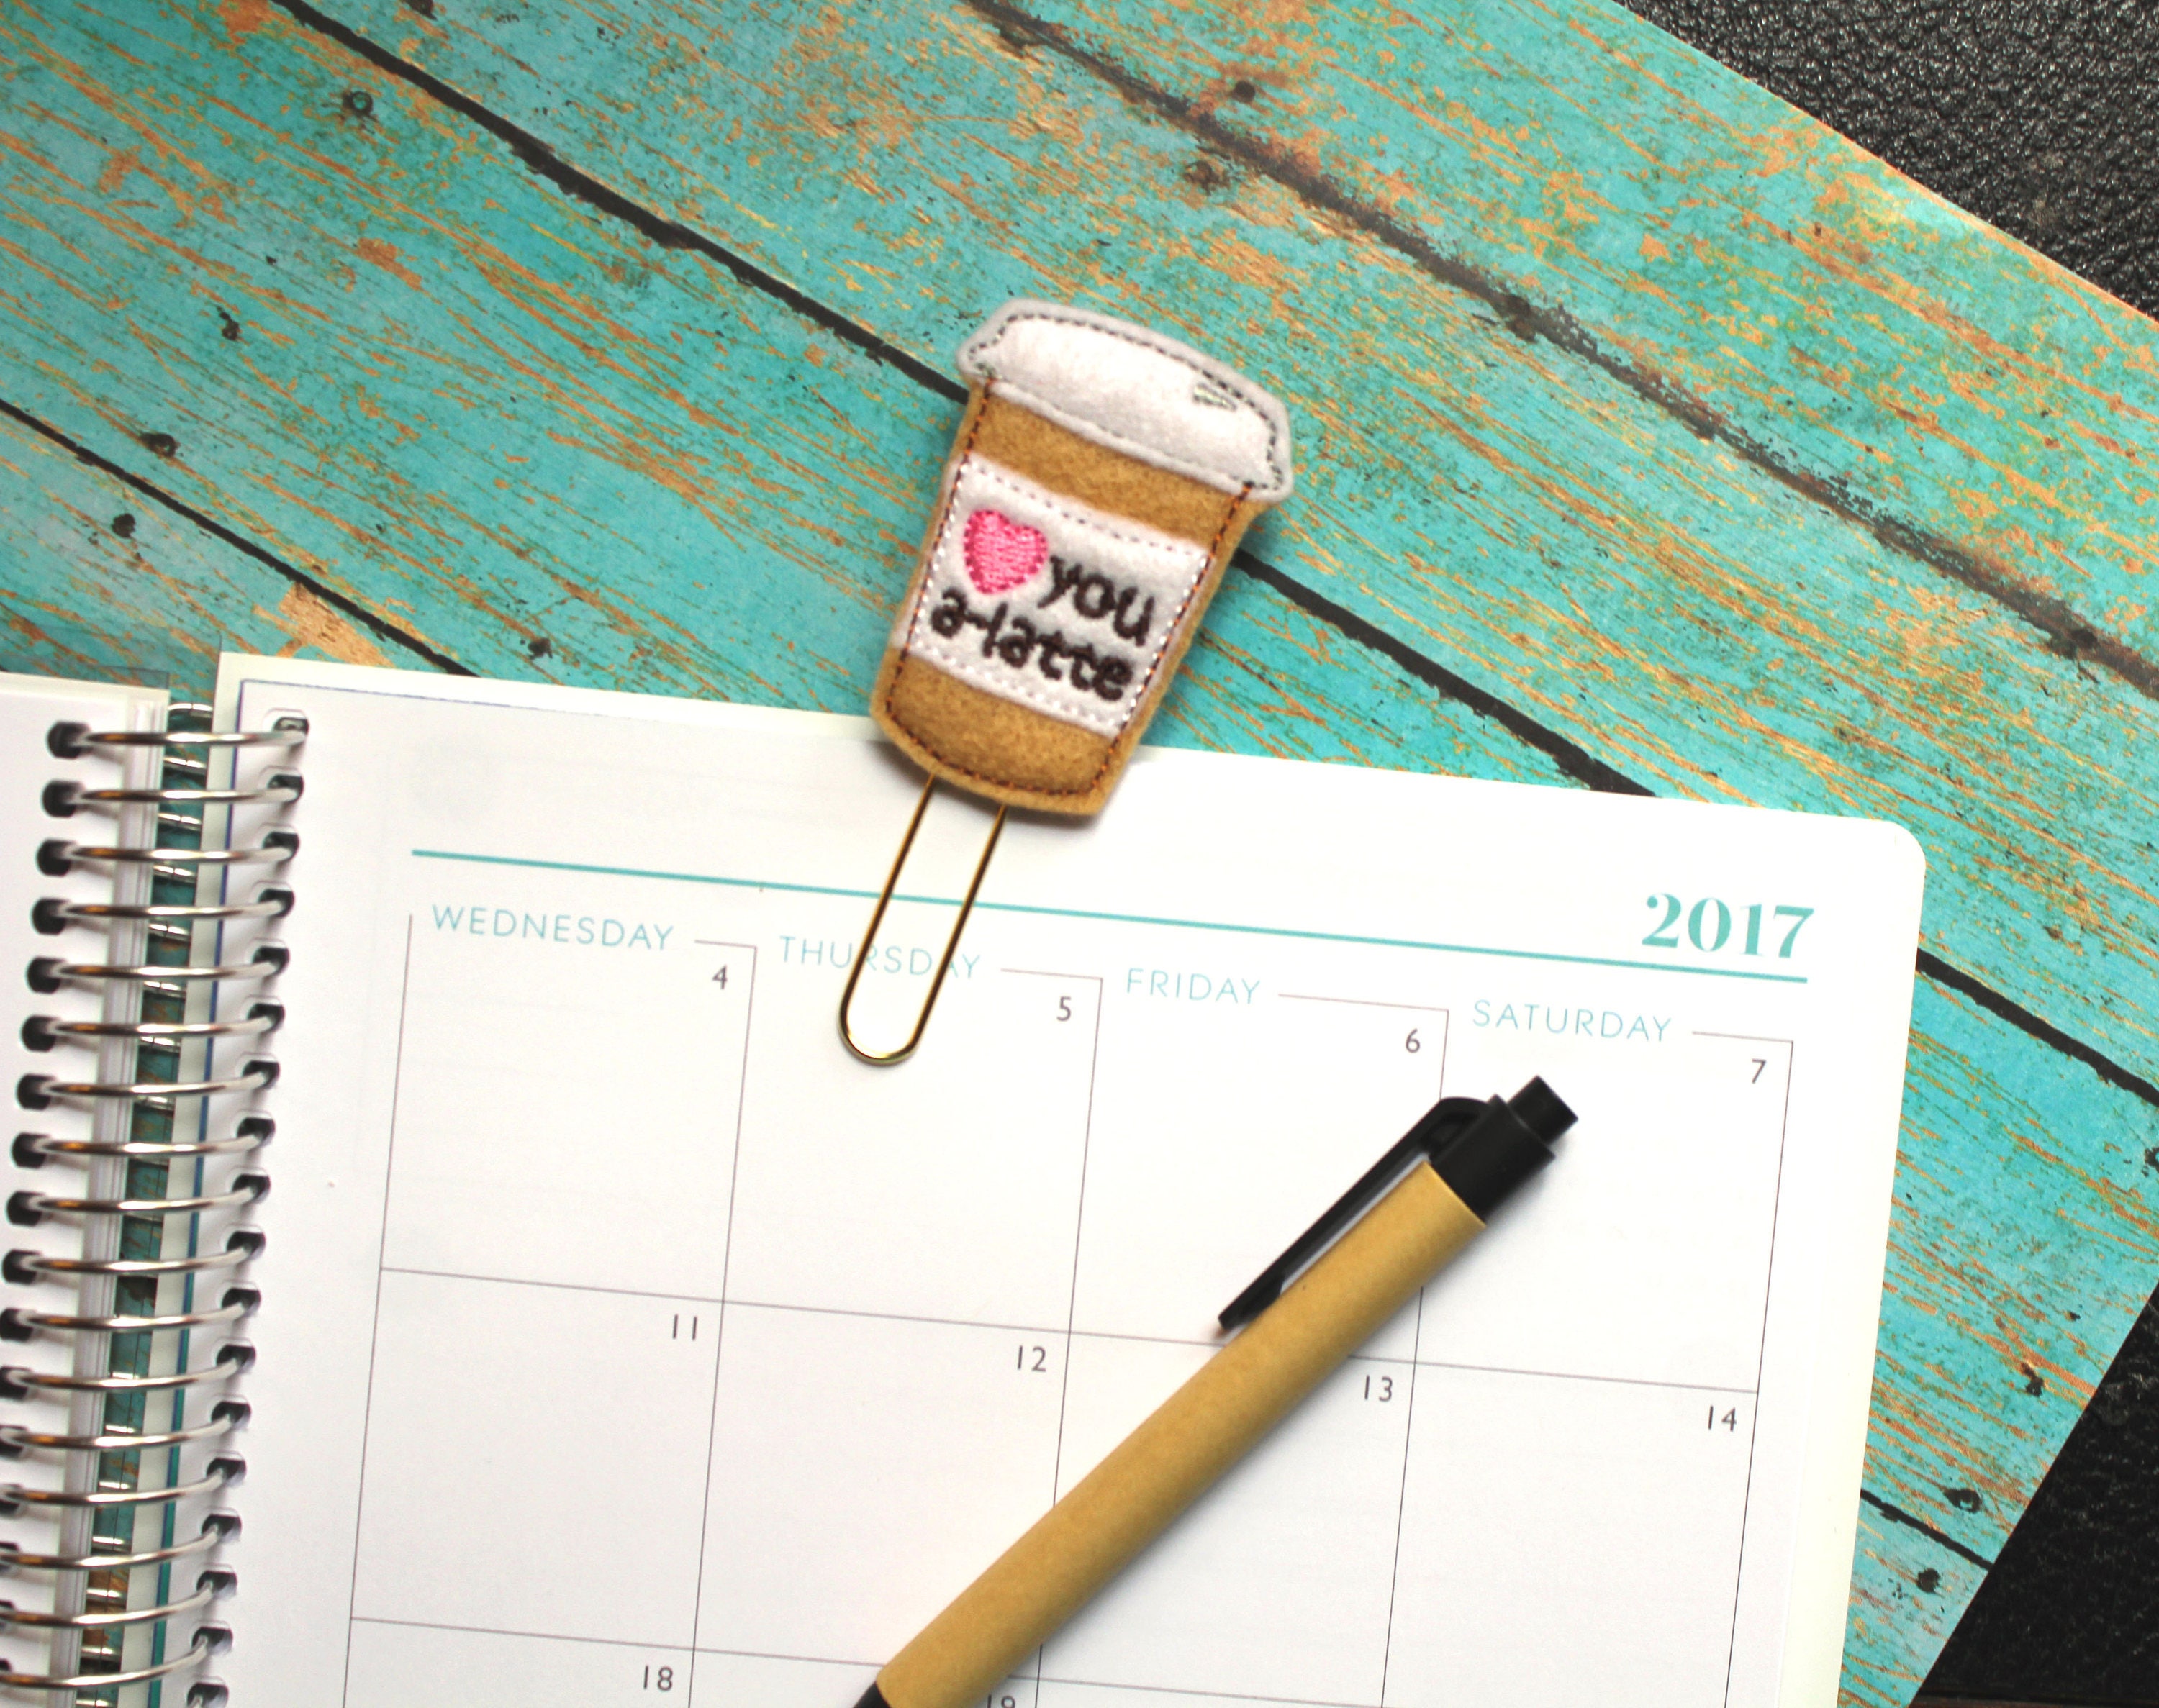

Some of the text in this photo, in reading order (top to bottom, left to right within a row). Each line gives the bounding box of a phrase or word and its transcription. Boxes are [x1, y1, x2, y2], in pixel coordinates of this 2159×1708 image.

[1037, 555, 1154, 646] you
[931, 589, 1133, 701] a-latte
[432, 904, 674, 950] WEDNESDAY
[1642, 894, 1814, 958] 2017
[712, 965, 728, 990] 4
[1126, 967, 1261, 1004] FRIDAY
[1056, 996, 1072, 1022] 5
[1473, 999, 1672, 1042] SATURDAY
[1405, 1027, 1421, 1054] 6
[1751, 1058, 1767, 1084] 7
[672, 1314, 699, 1341] 11
[1017, 1345, 1047, 1372] 12
[1364, 1375, 1394, 1402] 13
[1708, 1404, 1737, 1432] 14
[643, 1665, 674, 1692] 18
